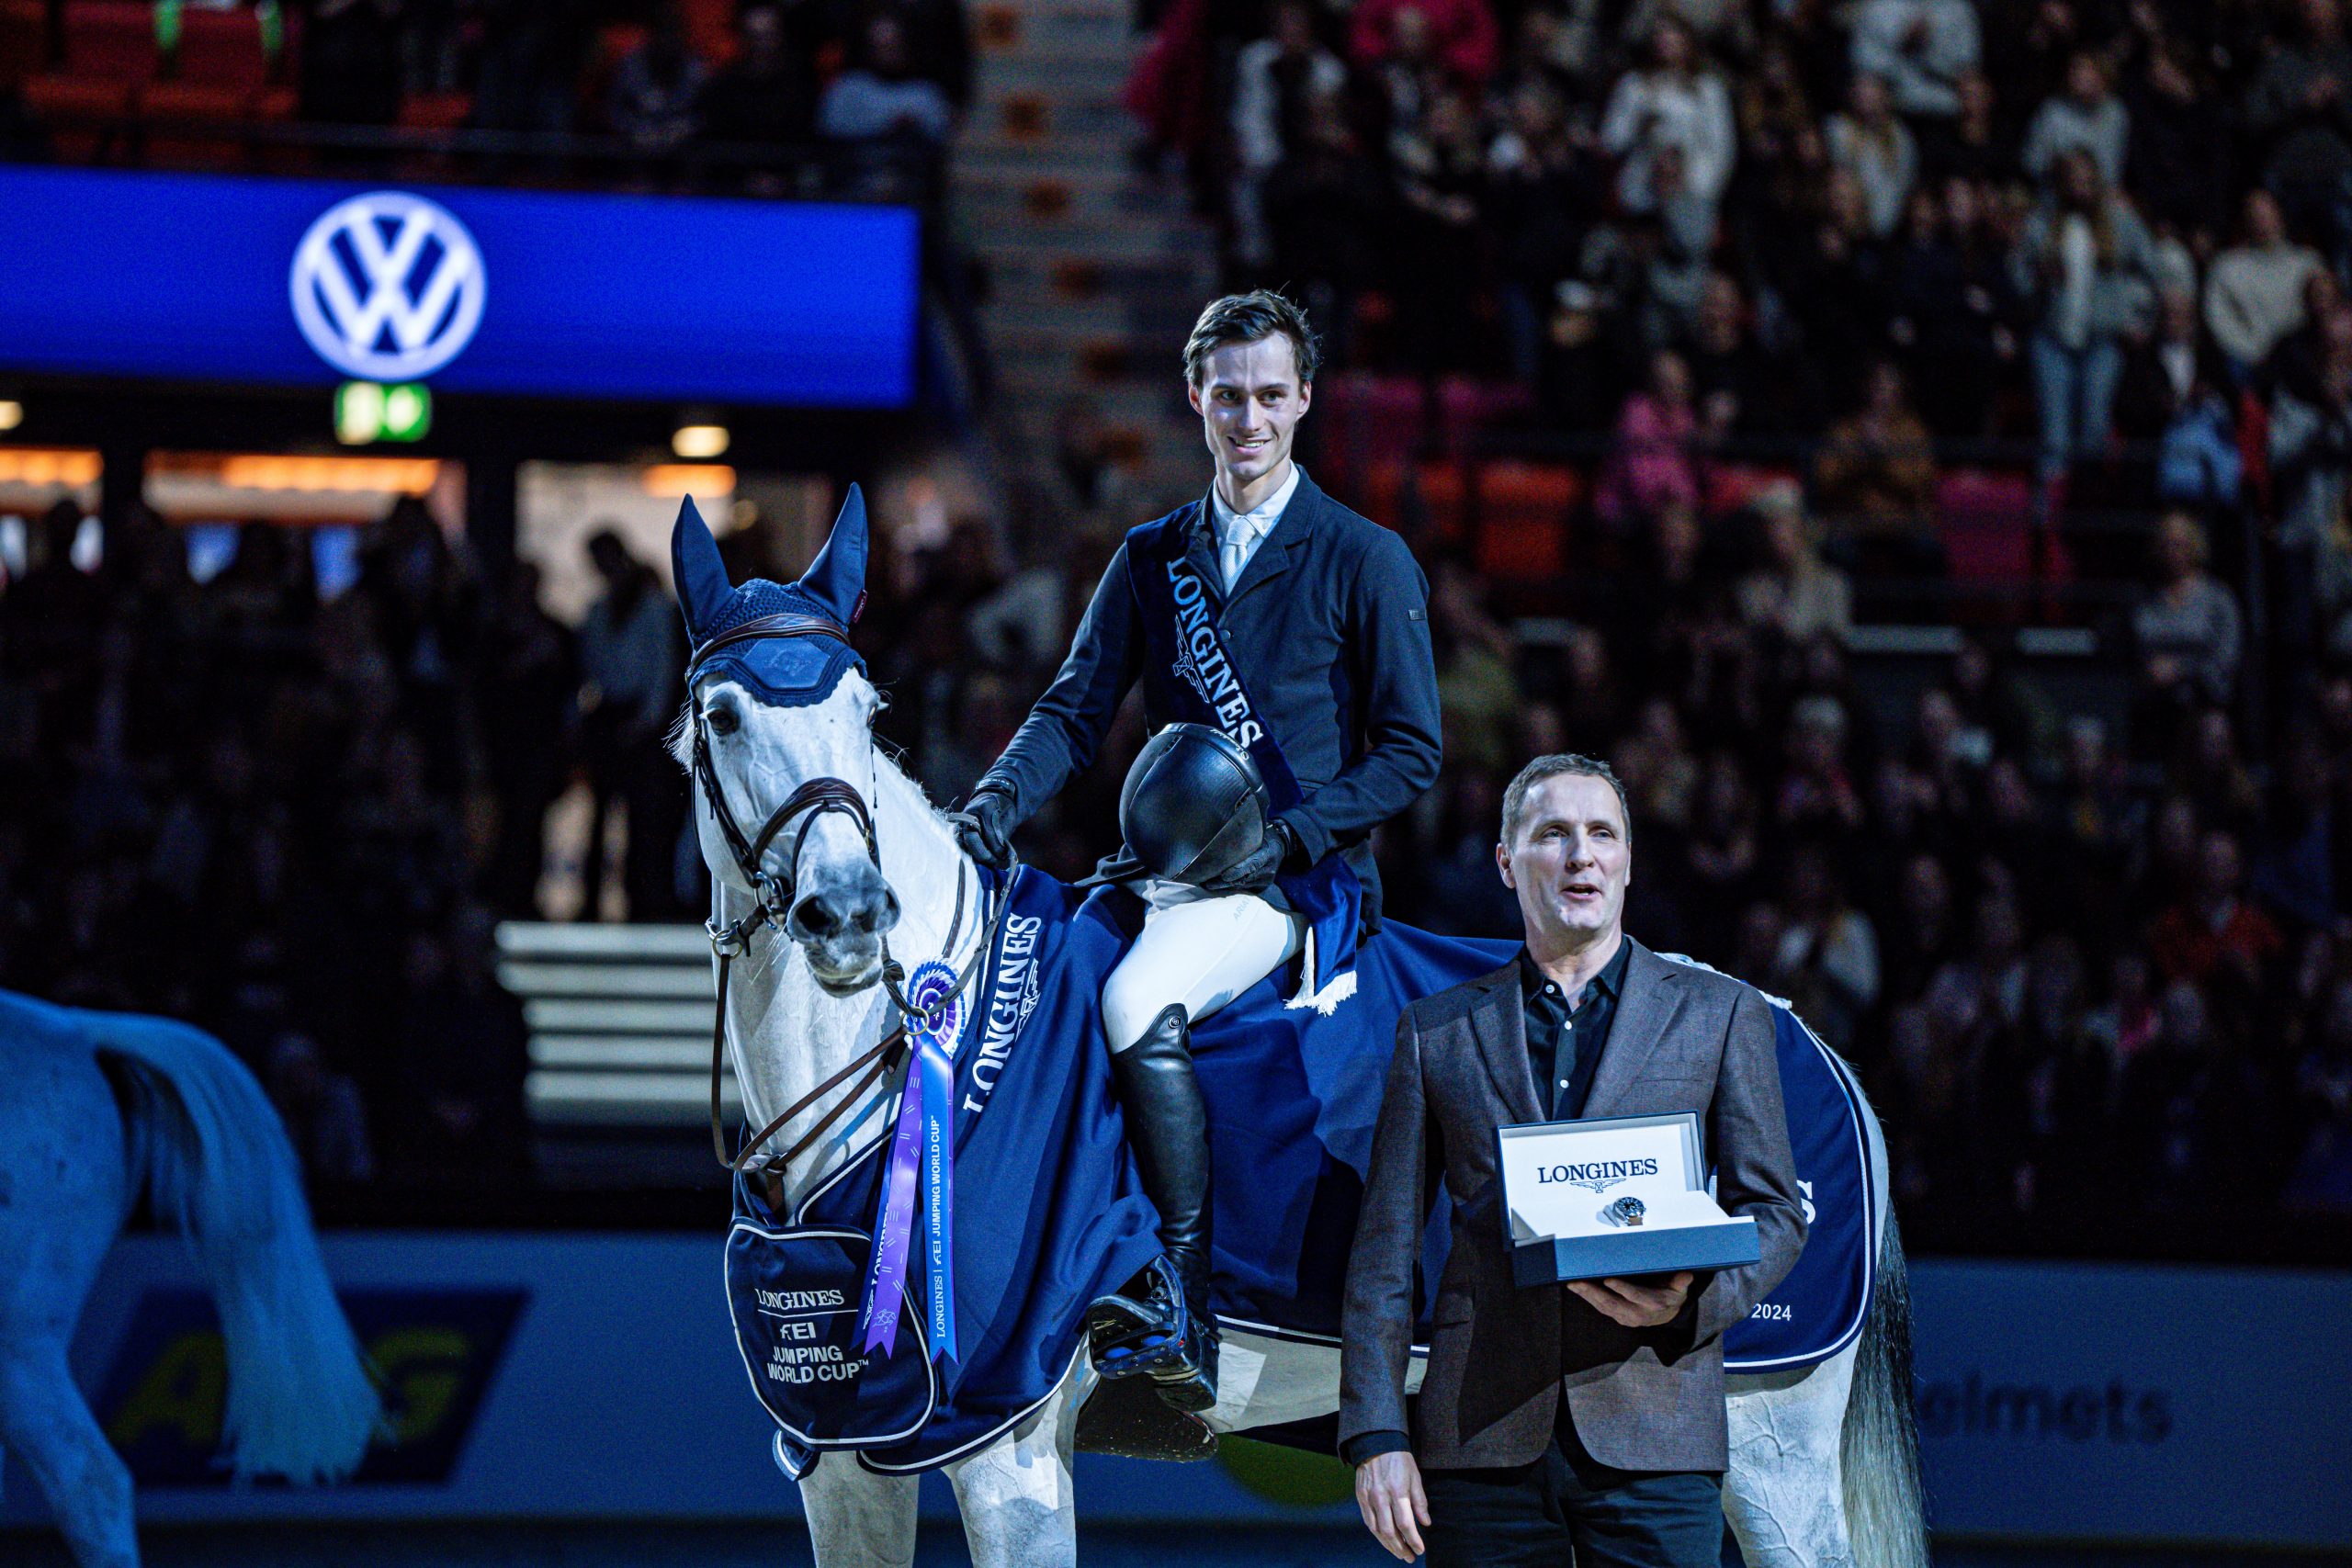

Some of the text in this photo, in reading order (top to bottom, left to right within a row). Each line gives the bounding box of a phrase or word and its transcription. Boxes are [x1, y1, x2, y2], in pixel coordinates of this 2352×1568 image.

[1166, 557, 1264, 749] LONGINES
[931, 1145, 941, 1185] WORLD
[1537, 1158, 1658, 1184] LONGINES
[932, 1186, 941, 1236] JUMPING
[754, 1288, 845, 1311] LONGINES
[934, 1275, 945, 1338] LONGINES
[1751, 1303, 1792, 1322] 2024
[780, 1322, 817, 1340] FEI
[773, 1345, 843, 1365] JUMPING
[107, 1326, 472, 1446] AG
[767, 1362, 815, 1384] WORLD
